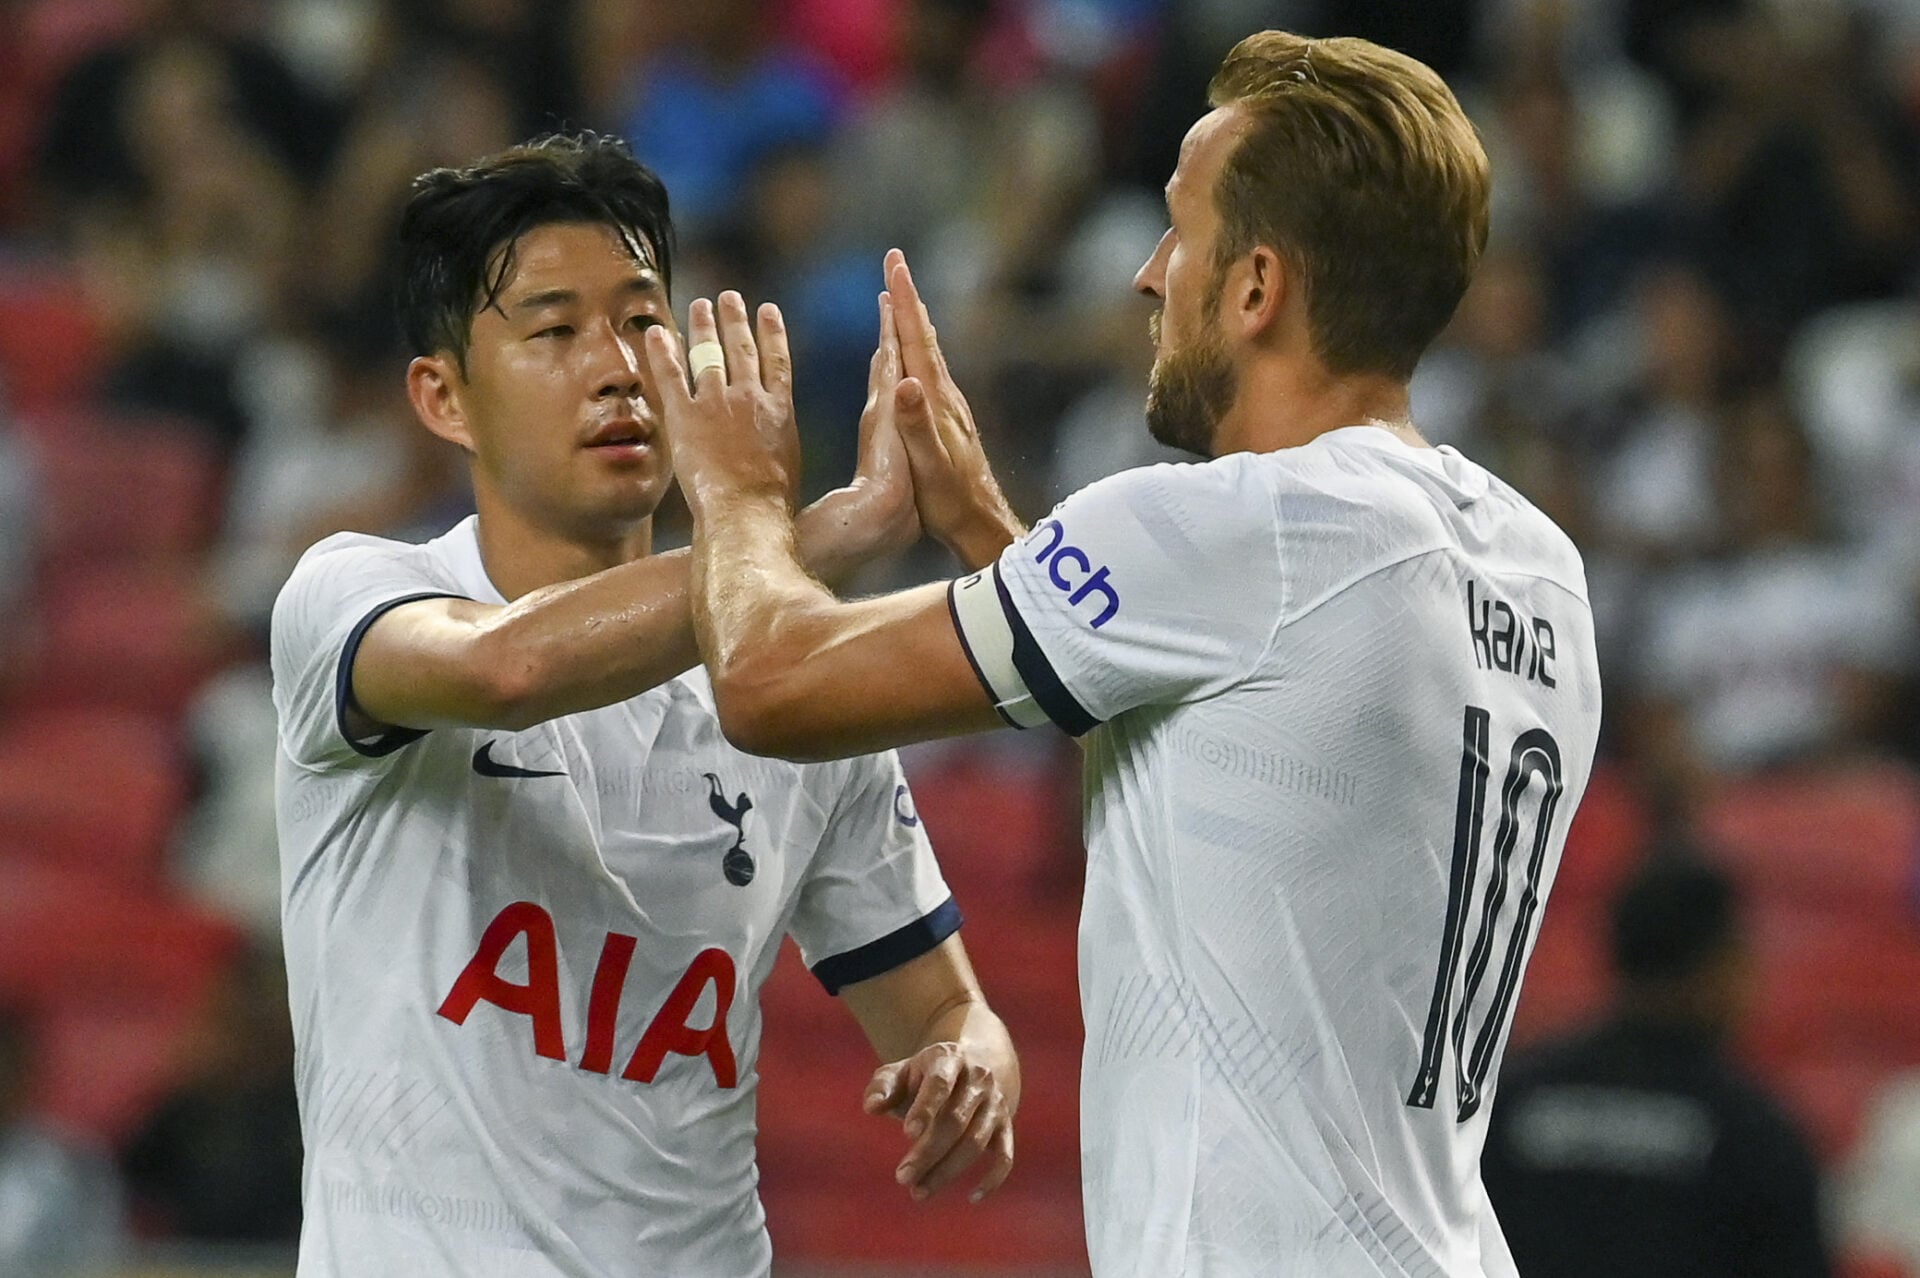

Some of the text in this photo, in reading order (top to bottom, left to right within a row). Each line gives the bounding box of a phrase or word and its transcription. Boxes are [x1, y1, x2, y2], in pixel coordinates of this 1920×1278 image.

[1024, 518, 1121, 630] nch
[436, 901, 737, 1089] AIA
[1405, 704, 1563, 1124] 10
